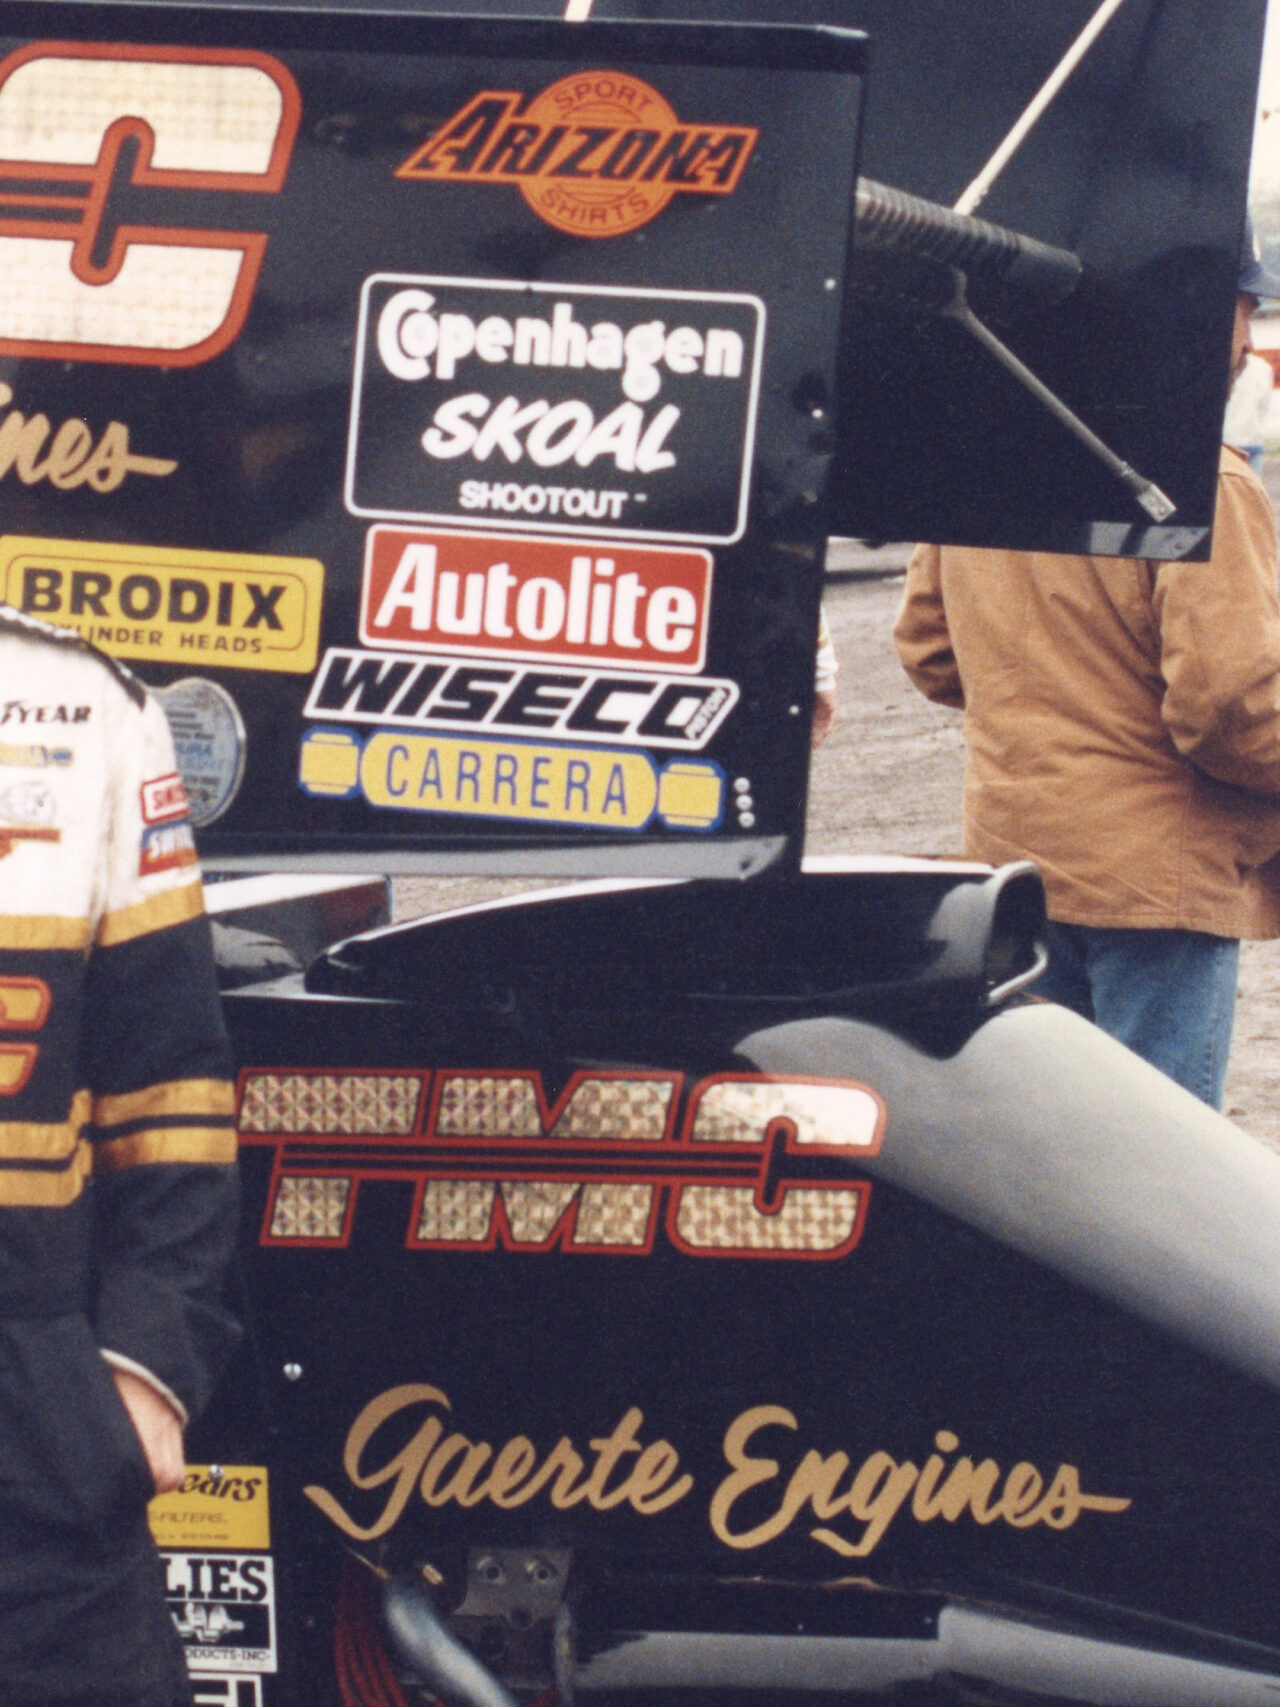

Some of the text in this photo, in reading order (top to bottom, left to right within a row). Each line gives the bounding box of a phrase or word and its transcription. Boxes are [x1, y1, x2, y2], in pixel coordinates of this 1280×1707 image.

[554, 79, 654, 112] SPORT
[408, 95, 752, 187] ARIZONA
[540, 186, 651, 226] SHIRTS
[376, 289, 744, 402] Copenhagen
[422, 394, 683, 473] SKOAL
[459, 479, 627, 520] SHOOTOUT
[21, 566, 288, 632] BRODIX
[373, 542, 697, 654] Autolite
[179, 632, 263, 655] HEADS
[311, 655, 730, 743] WISECO
[385, 744, 630, 817] CARRERA
[237, 1067, 887, 1260] TMC
[303, 1383, 1132, 1558] Gaerte Engines
